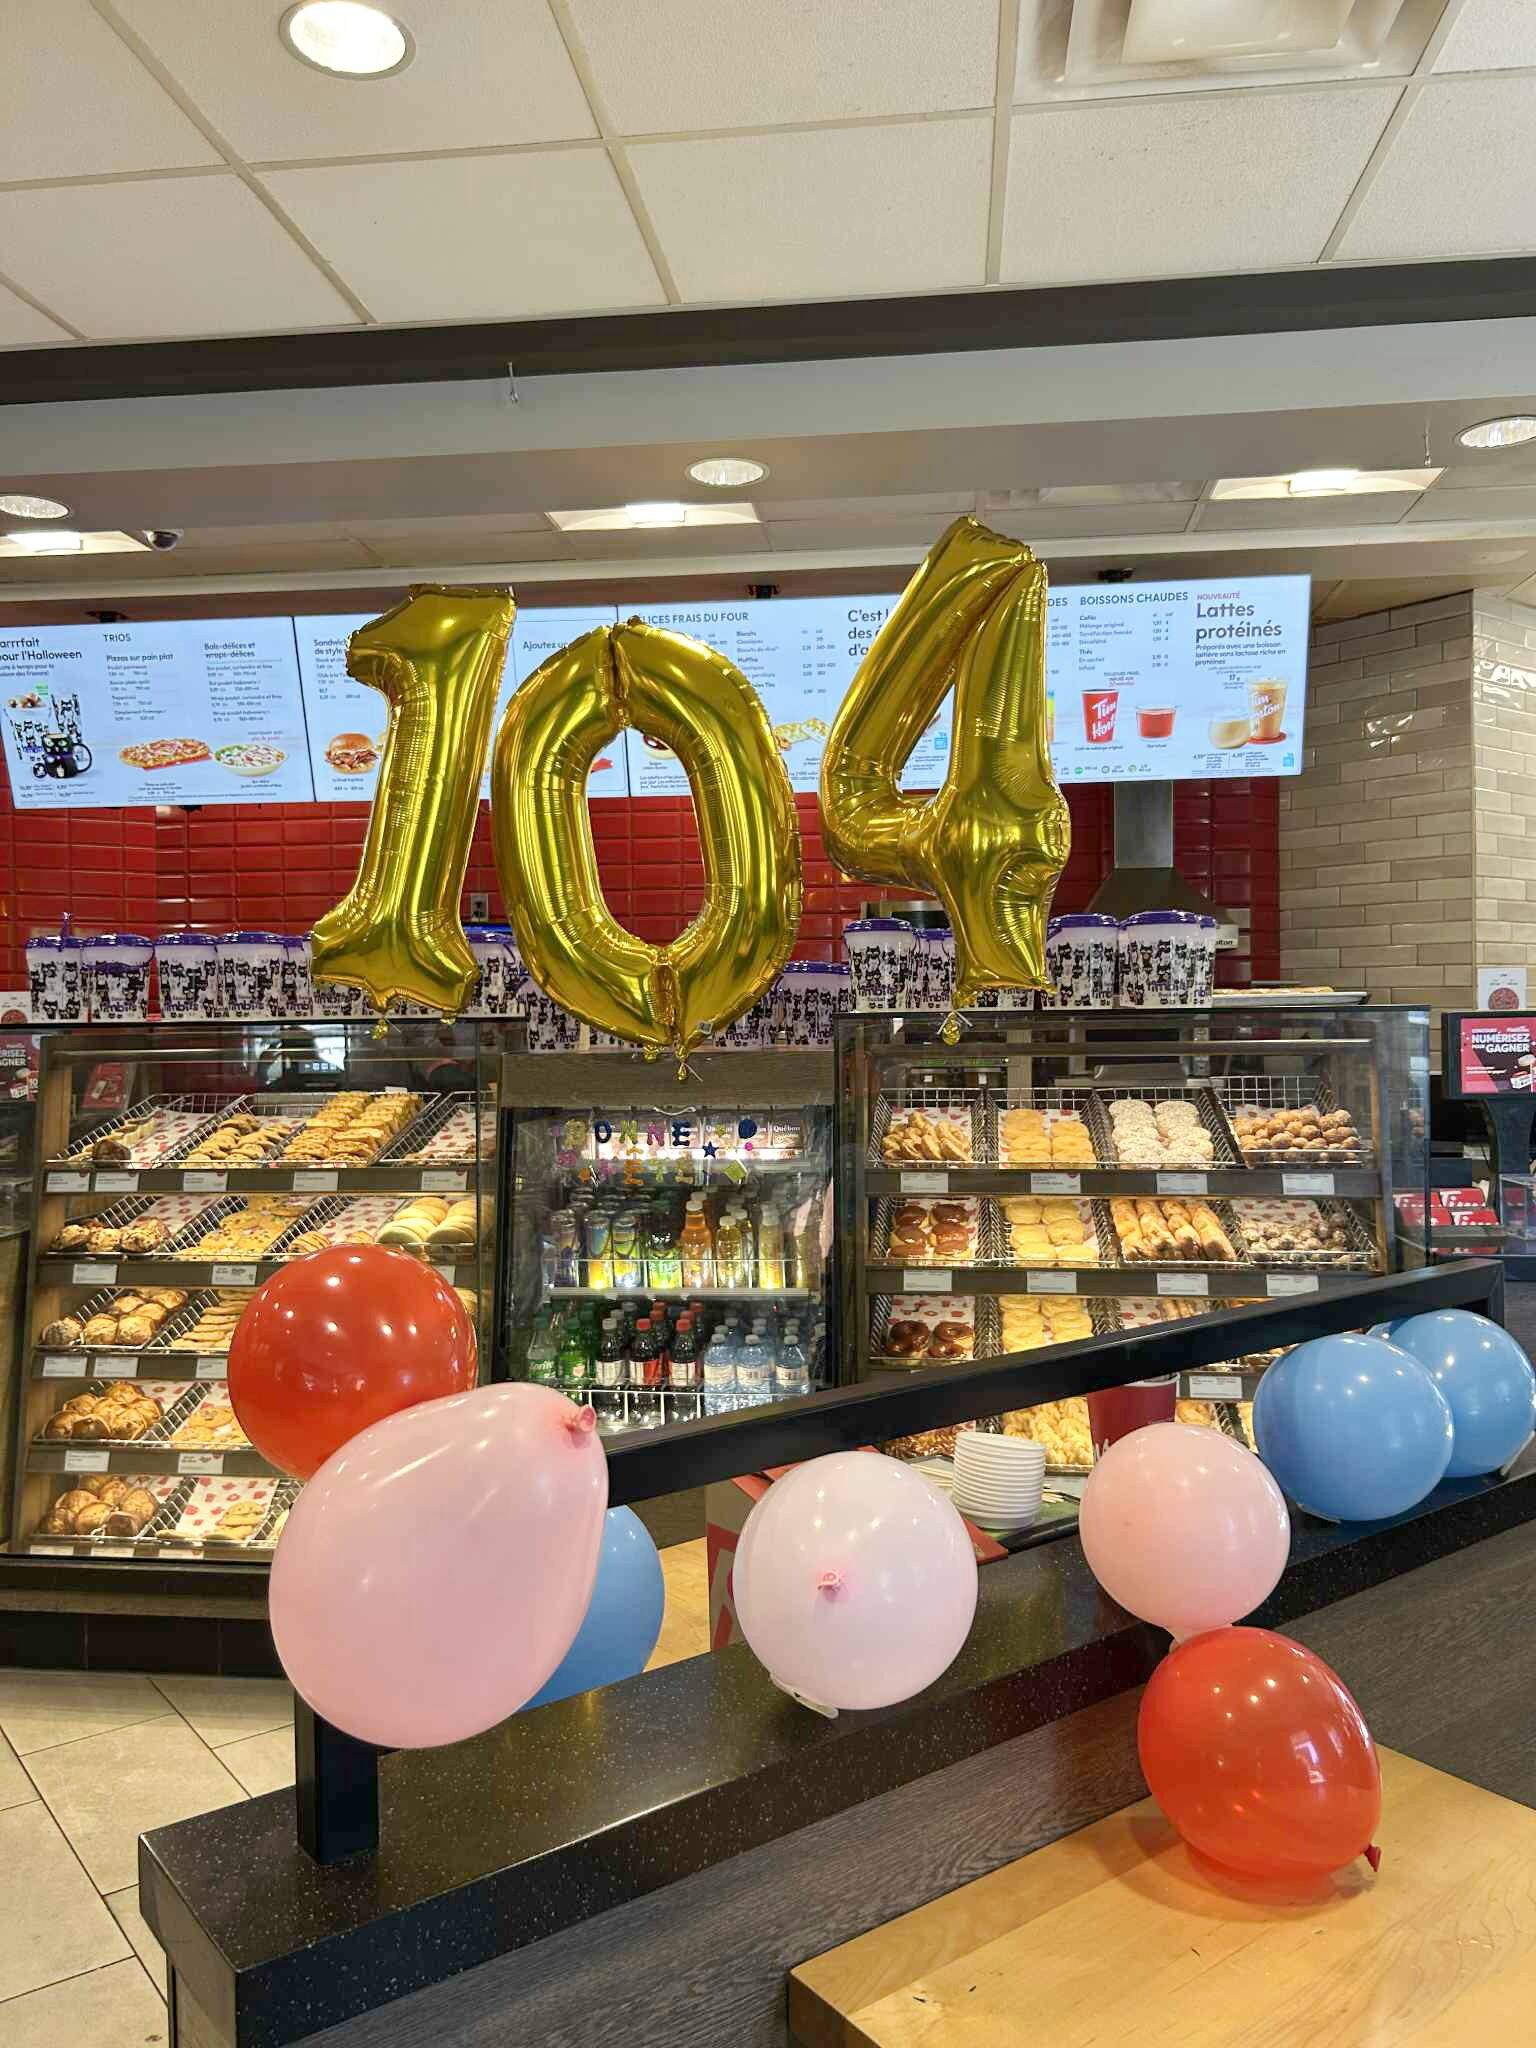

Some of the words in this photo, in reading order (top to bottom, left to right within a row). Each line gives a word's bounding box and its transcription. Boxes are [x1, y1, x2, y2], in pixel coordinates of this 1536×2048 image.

[1080, 594, 1134, 606] BOISSONS
[1137, 592, 1188, 603] CHAUDES
[1197, 591, 1240, 600] NOUVEAUTÉ
[1047, 597, 1068, 607] DES
[848, 609, 882, 622] C'est
[1197, 602, 1255, 618] Lattes
[642, 615, 670, 625] LICES
[673, 614, 701, 624] FRAIS
[704, 613, 718, 622] DU
[721, 611, 749, 621] FOUR
[848, 627, 872, 639] des
[1195, 619, 1282, 643] protéinés
[0, 637, 40, 648] arrrfait
[104, 633, 131, 642] TRIOS
[523, 641, 556, 651] Ajoutez
[849, 643, 869, 656] d'a
[0, 652, 20, 661] our
[22, 650, 82, 661] l'Halloween
[311, 516, 1072, 1048] 104
[1472, 1030, 1530, 1043] NUMÉRISEZ
[1486, 1043, 1530, 1053] GAGNER
